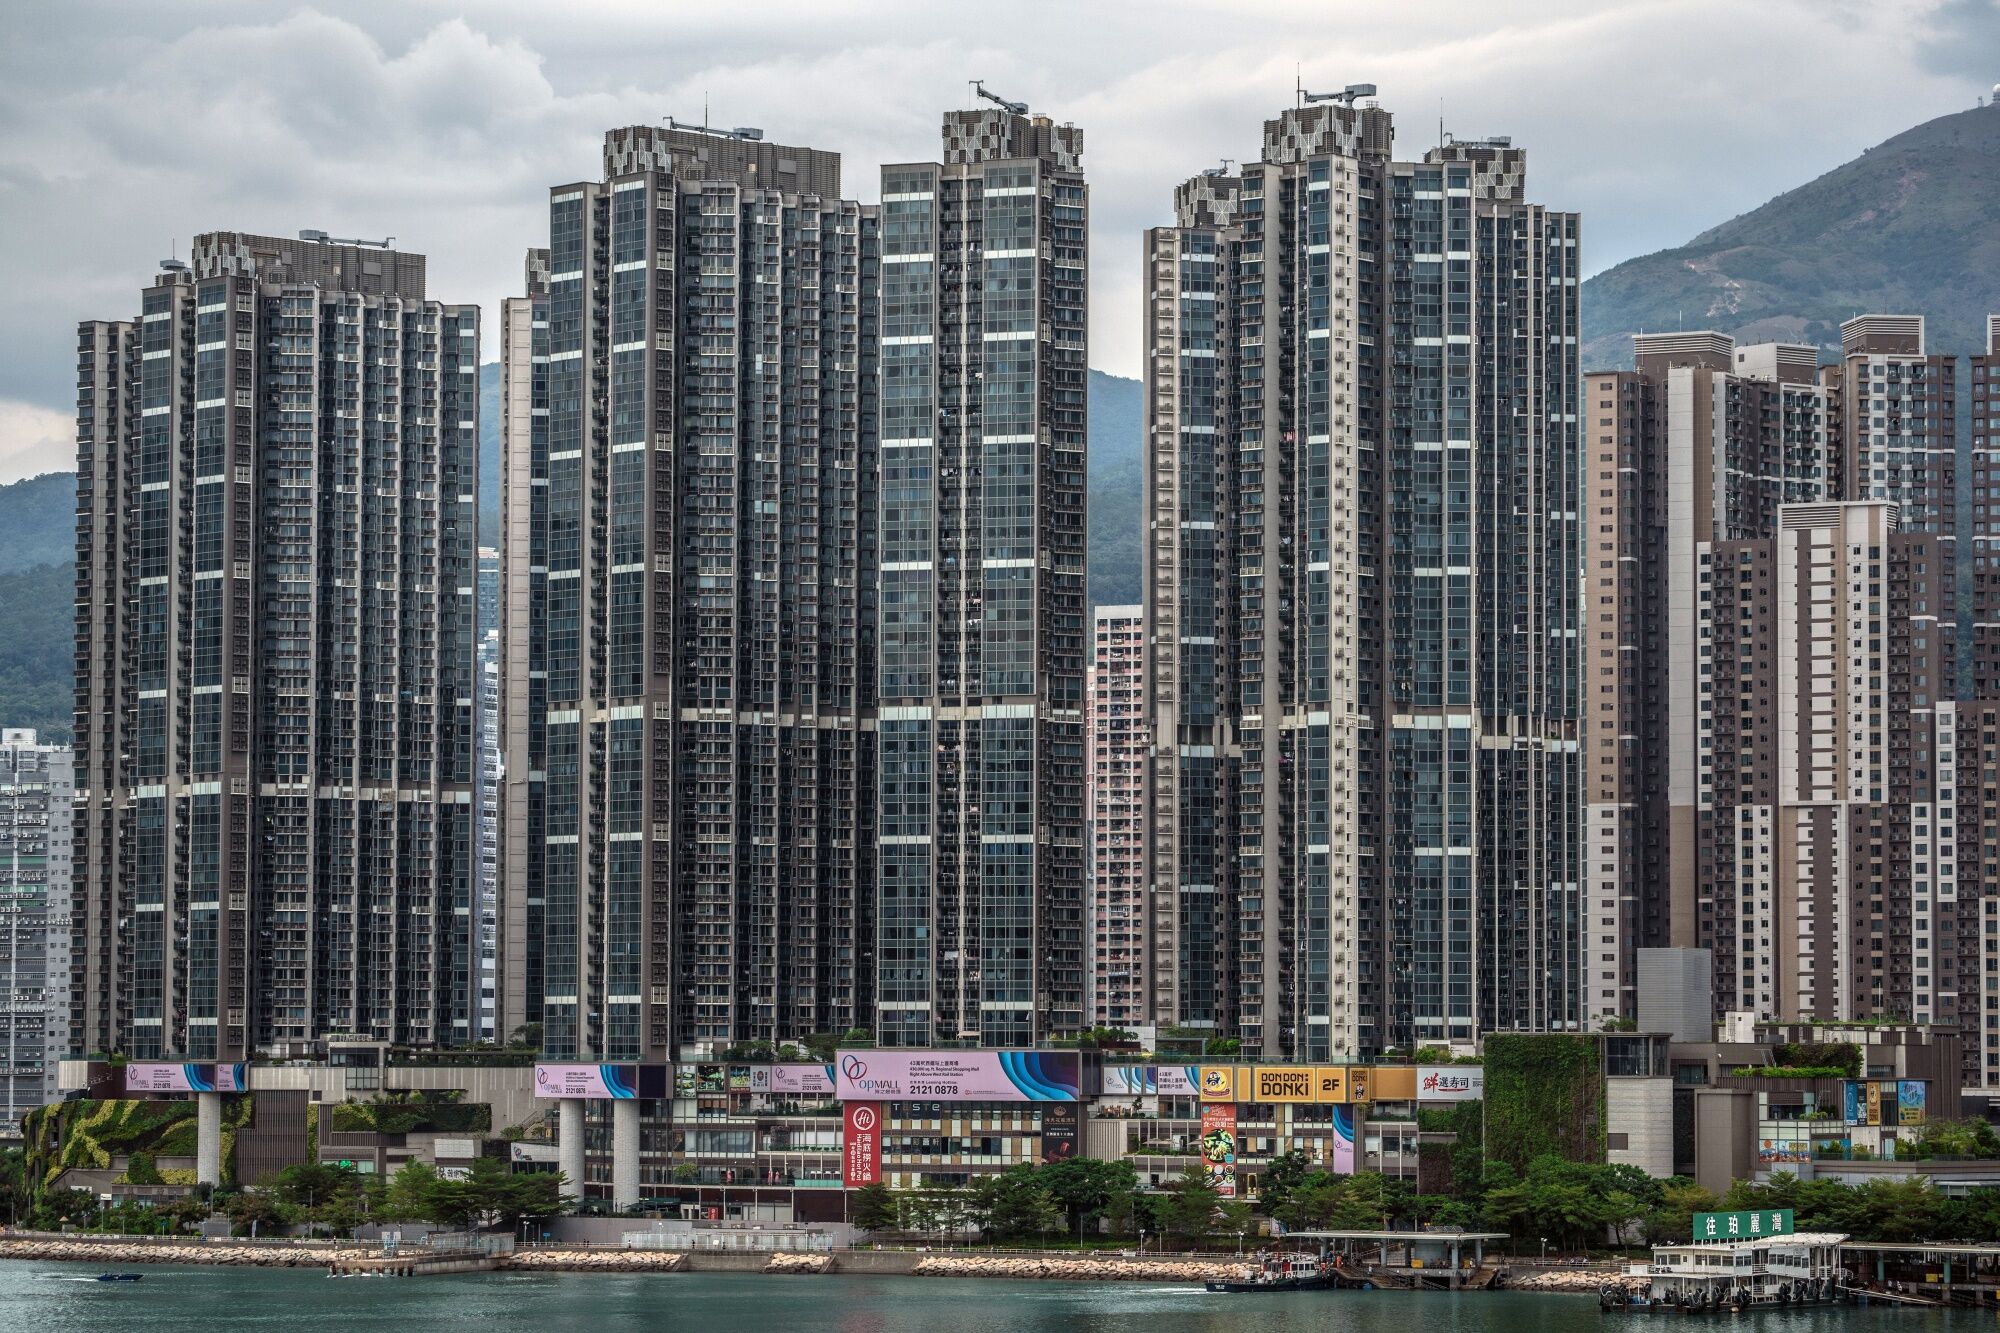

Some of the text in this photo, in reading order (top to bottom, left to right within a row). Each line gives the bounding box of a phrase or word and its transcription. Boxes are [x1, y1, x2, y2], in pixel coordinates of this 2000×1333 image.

[1261, 1073, 1281, 1082] DON
[910, 1085, 959, 1095] 2121 0878
[1261, 1082, 1309, 1096] DONKI
[1322, 1079, 1340, 1091] 2F
[862, 1133, 872, 1181] 海底撈火鍋
[1706, 1212, 1782, 1236] 往珀麗灣
